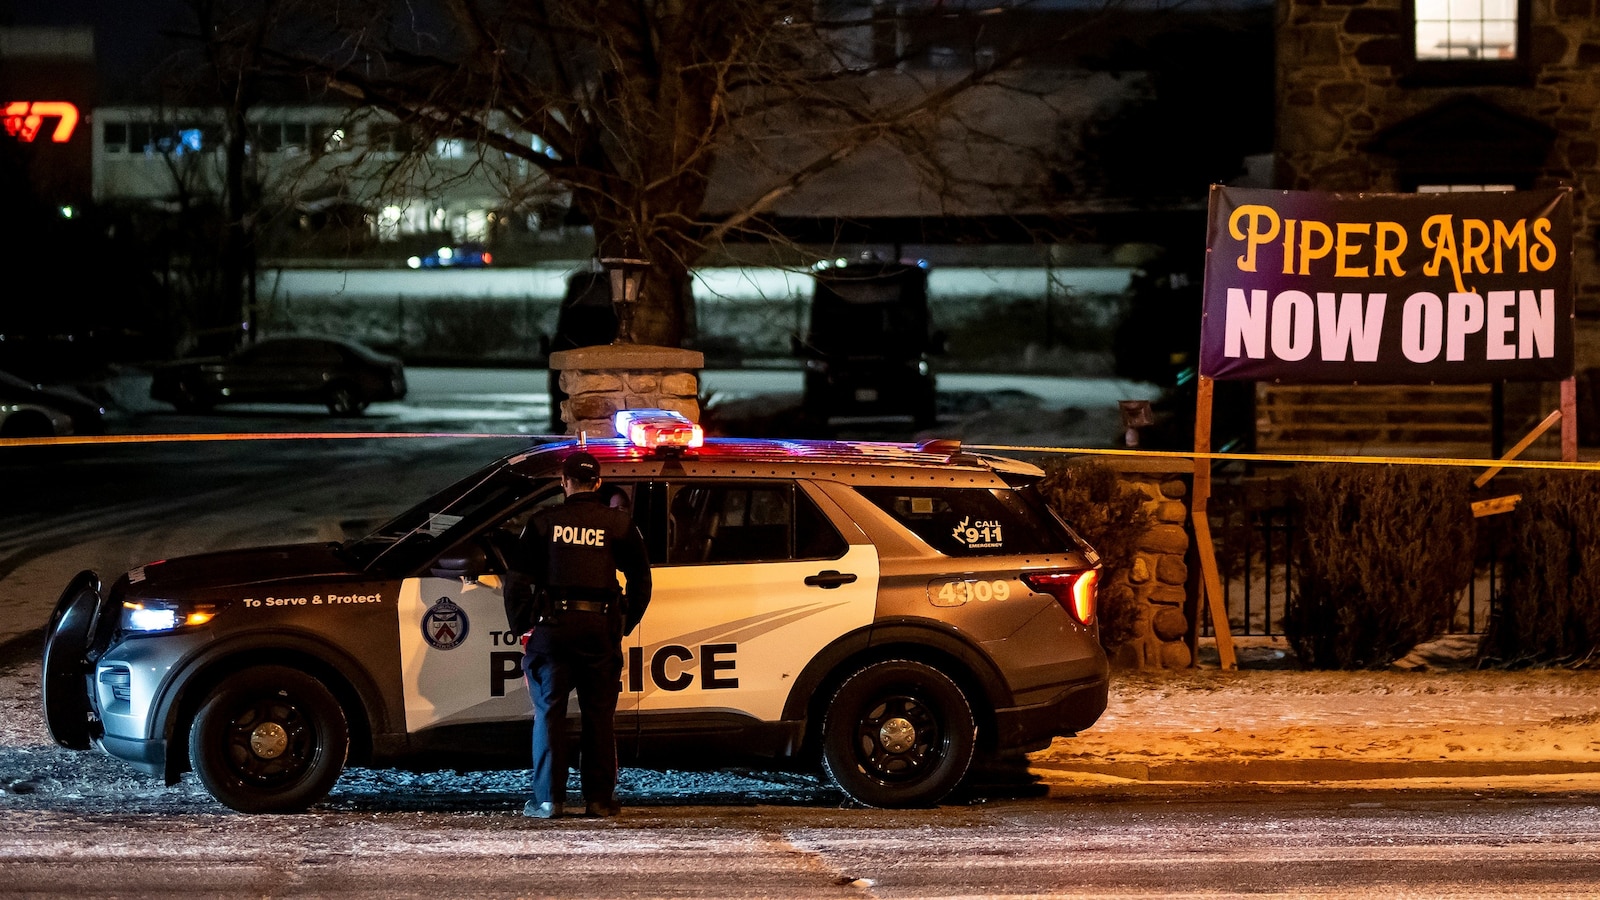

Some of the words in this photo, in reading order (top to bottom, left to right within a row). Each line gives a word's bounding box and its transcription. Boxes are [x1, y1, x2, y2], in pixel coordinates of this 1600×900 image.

[1228, 204, 1409, 277] PIPER
[1421, 214, 1557, 294] ARMS
[1224, 288, 1388, 362] NOW
[1401, 289, 1555, 363] OPEN
[965, 527, 1003, 543] 9-1-1
[974, 520, 1002, 528] CALL
[553, 525, 605, 547] POLICE
[243, 598, 262, 608] To
[265, 597, 307, 607] Serve
[311, 594, 323, 605] &
[327, 592, 382, 605] Protect
[938, 580, 1010, 603] 4309
[490, 644, 739, 697] PICE
